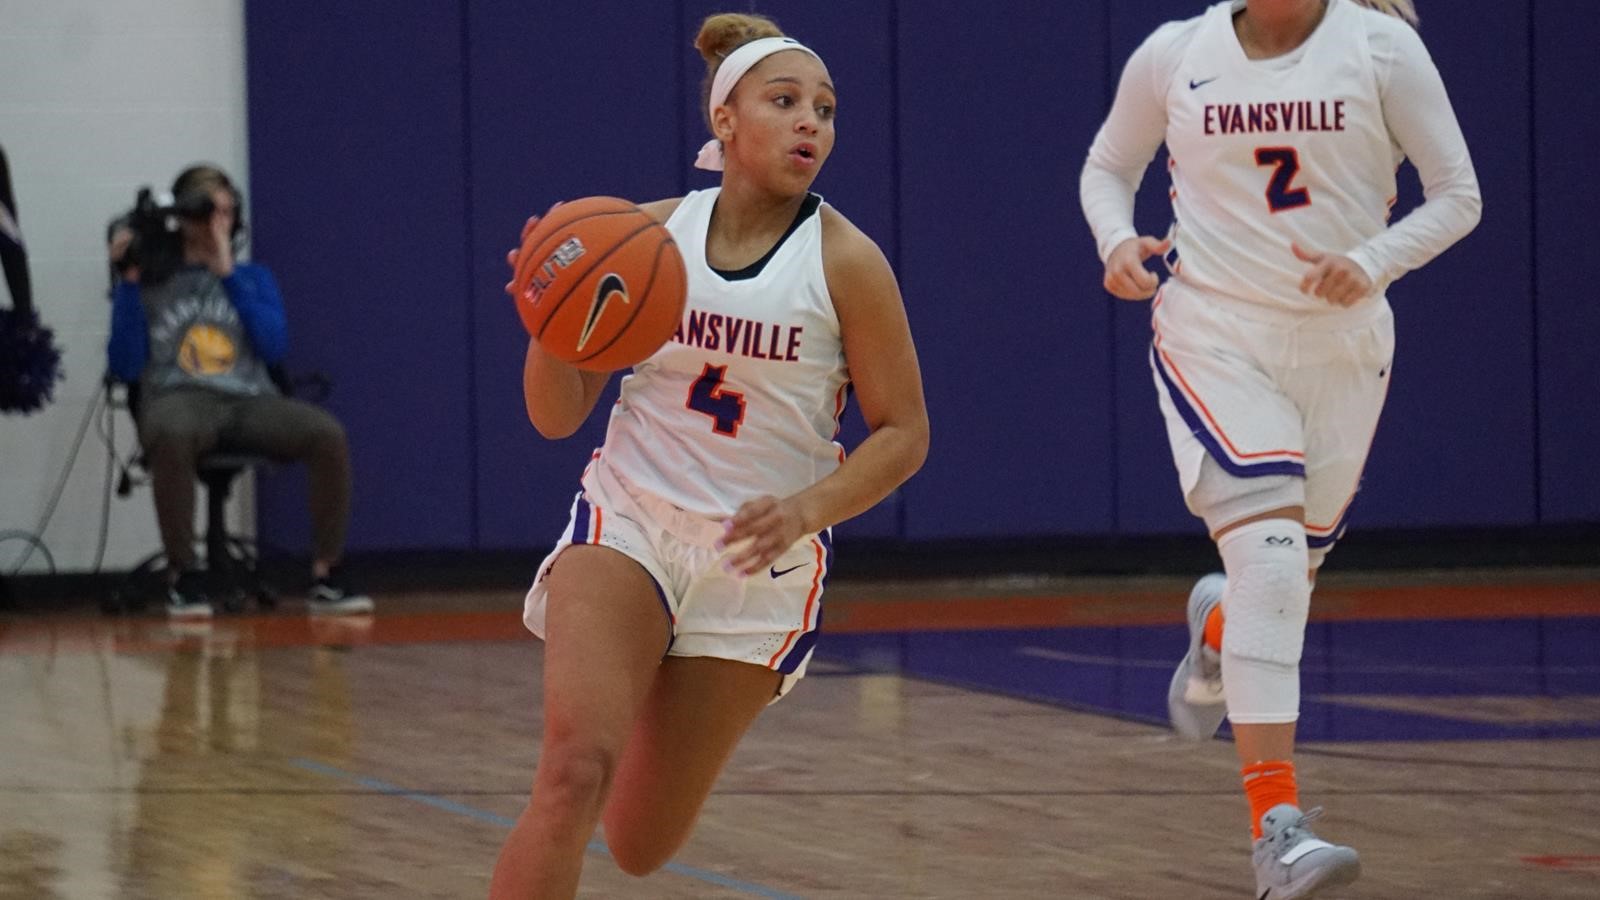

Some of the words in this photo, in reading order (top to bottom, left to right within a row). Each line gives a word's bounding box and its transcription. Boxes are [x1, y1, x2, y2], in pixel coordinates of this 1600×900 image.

[1203, 100, 1346, 136] EVANSVILLE
[1254, 146, 1312, 215] 2
[671, 309, 803, 363] ANSVILLE
[685, 362, 747, 439] 4
